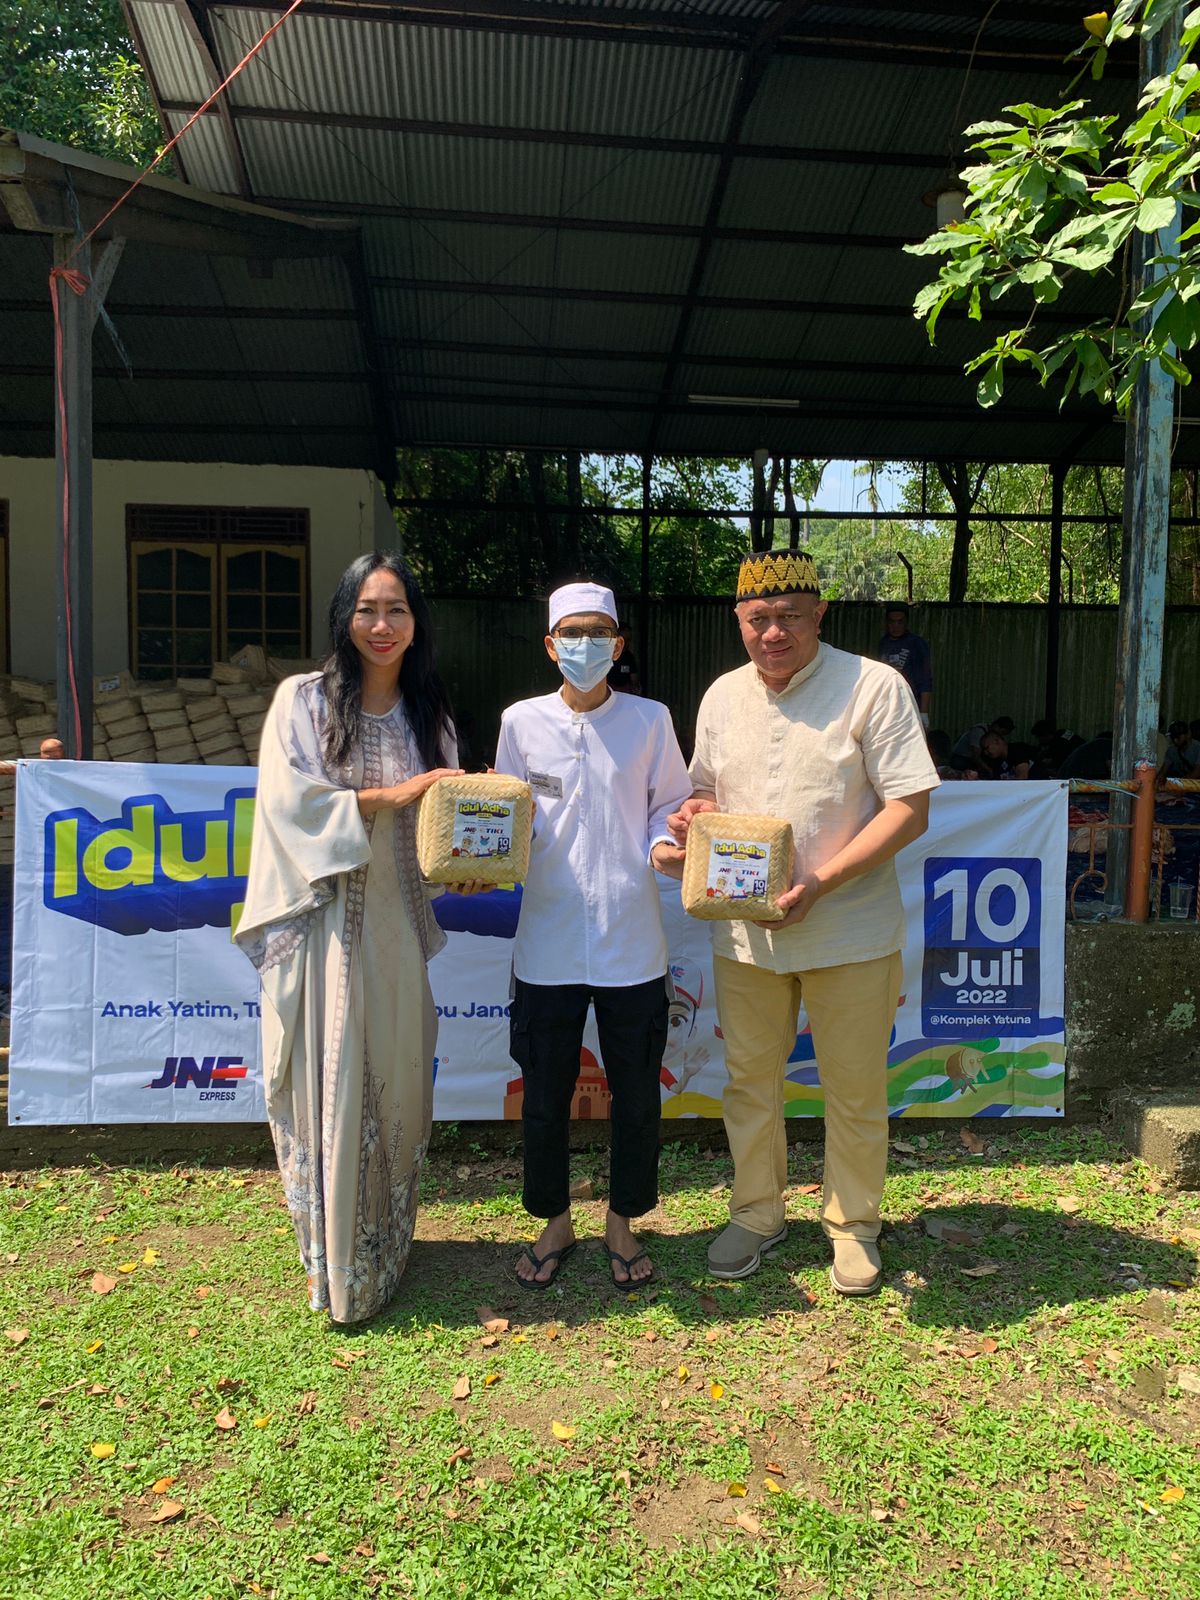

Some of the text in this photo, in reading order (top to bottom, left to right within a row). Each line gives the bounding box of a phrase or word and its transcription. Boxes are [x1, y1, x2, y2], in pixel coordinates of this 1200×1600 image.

[459, 802, 480, 813] Idul
[481, 803, 510, 816] Adha
[499, 838, 509, 846] 10
[738, 844, 766, 857] Adha
[754, 880, 765, 888] 10
[932, 867, 1031, 943] 10
[940, 949, 1023, 987] Juli
[956, 989, 1007, 1004] 2022
[101, 1001, 162, 1018] Anak
[168, 1001, 238, 1020] Yatim,
[930, 1013, 1031, 1027] @Komplek Yatuna
[150, 1056, 248, 1089] JNE
[199, 1091, 237, 1101] EXPRESS
